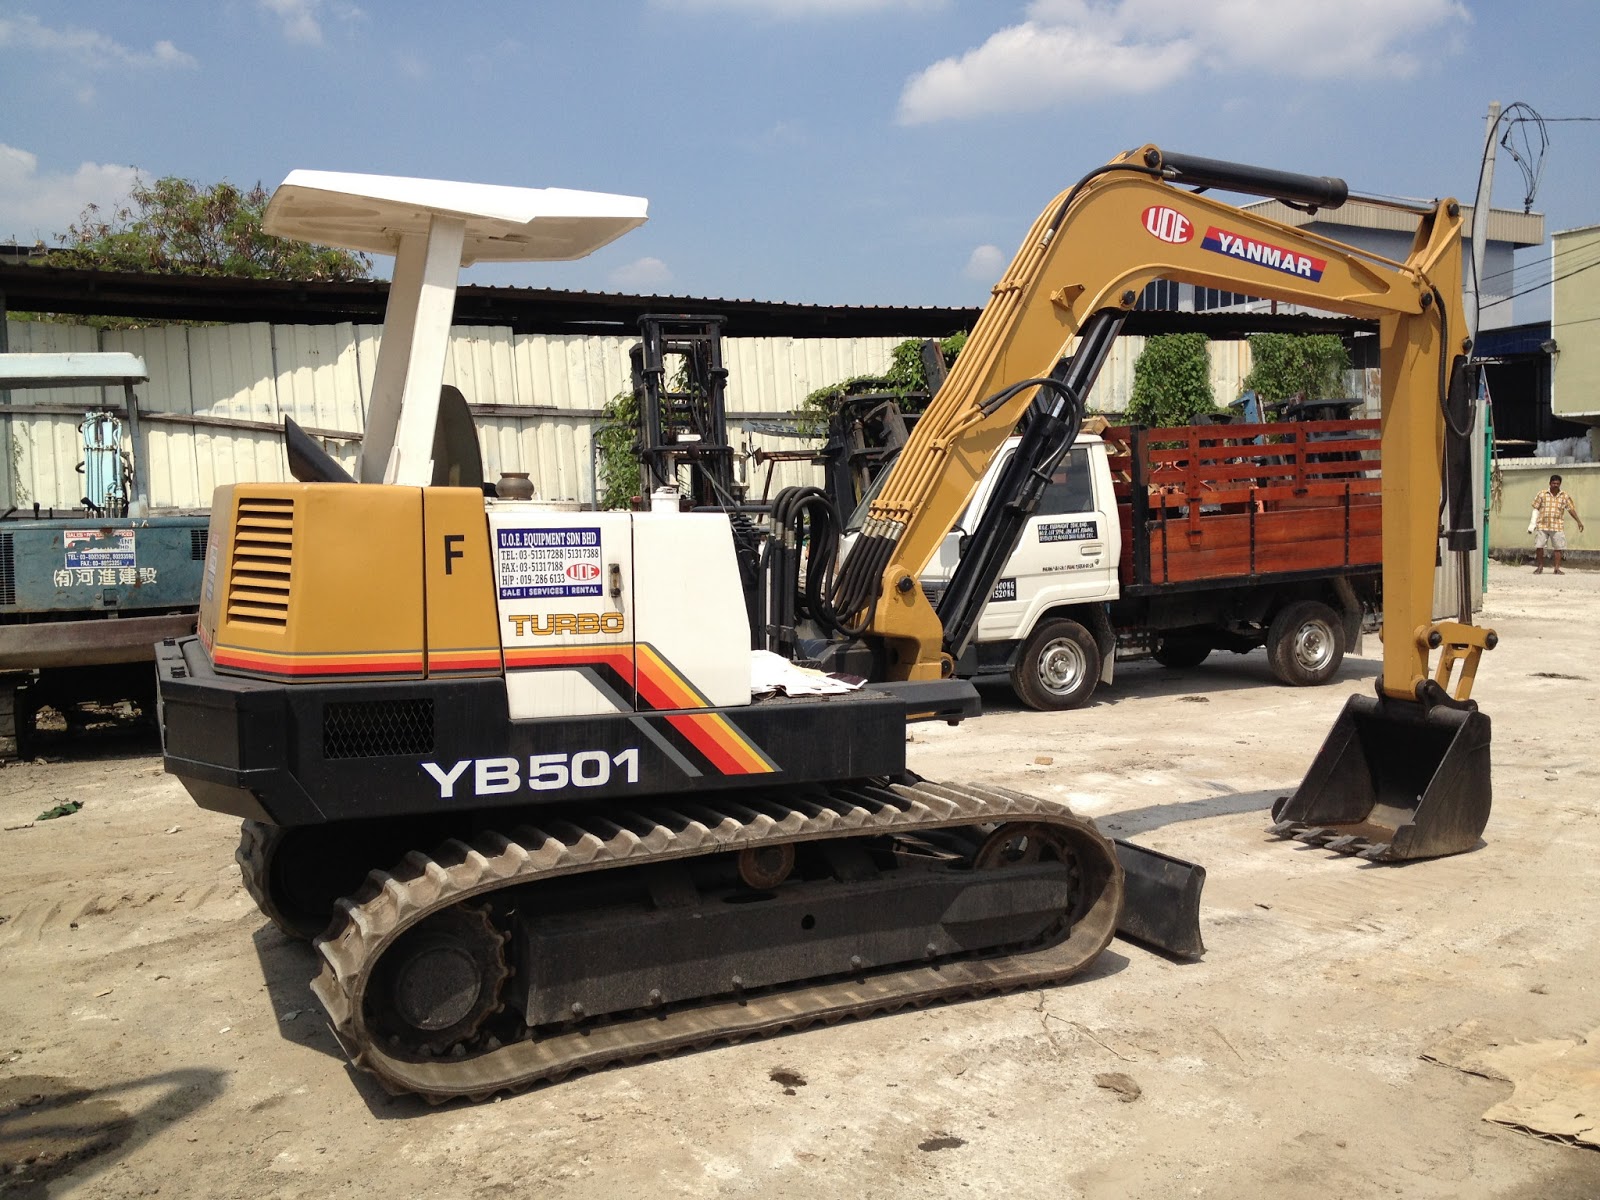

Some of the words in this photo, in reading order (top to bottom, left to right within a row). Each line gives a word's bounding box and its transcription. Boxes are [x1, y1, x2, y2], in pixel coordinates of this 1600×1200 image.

[1217, 231, 1313, 277] YANMAR
[501, 534, 523, 546] U.O.E.
[523, 532, 565, 548] EQUIPMENT
[566, 532, 580, 545] SDN
[581, 531, 597, 545] BHD
[444, 534, 464, 575] F
[501, 550, 518, 561] TEL:
[501, 562, 518, 573] FAX:
[502, 588, 521, 597] SALE
[528, 587, 564, 596] SERVICES
[571, 586, 599, 594] RENTAL
[508, 612, 624, 636] TURBO
